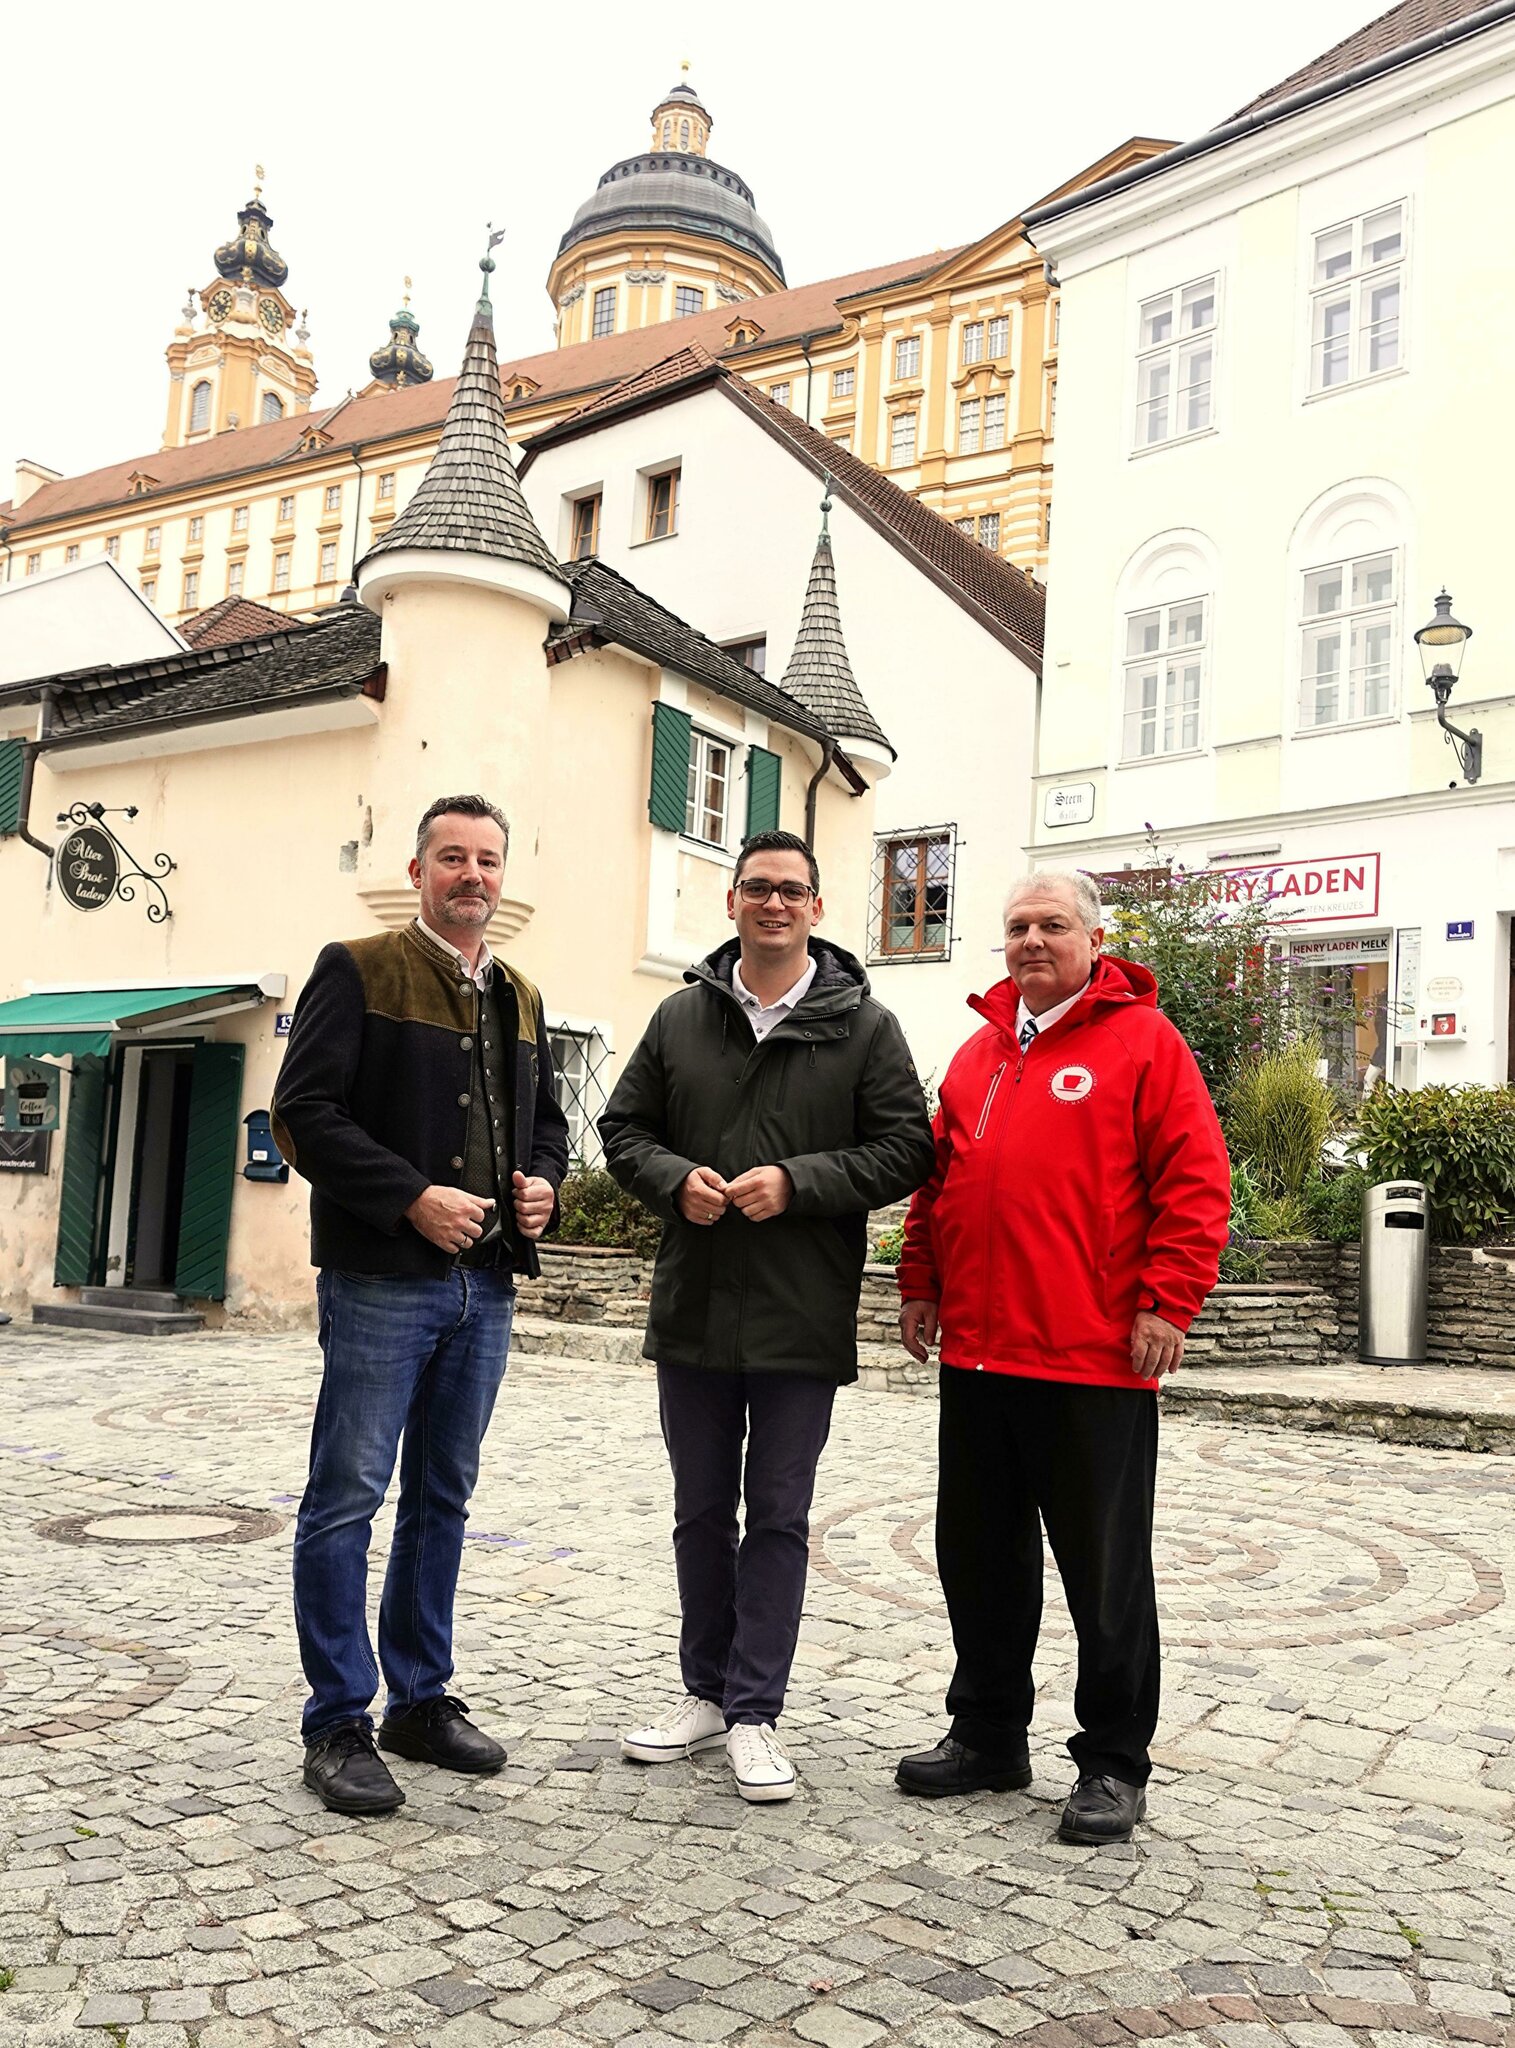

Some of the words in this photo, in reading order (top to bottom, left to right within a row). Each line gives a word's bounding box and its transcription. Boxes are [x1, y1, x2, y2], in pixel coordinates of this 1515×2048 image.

[67, 837, 104, 861] Alter
[69, 860, 108, 883] Brot-
[1267, 866, 1365, 898] LADEN
[1327, 900, 1364, 912] KREUZES
[1457, 923, 1462, 933] 1
[1293, 943, 1325, 954] HENRY
[1326, 941, 1359, 952] LADEN
[1361, 939, 1388, 949] MELK
[281, 1015, 293, 1028] 13
[20, 1101, 42, 1112] Coffee
